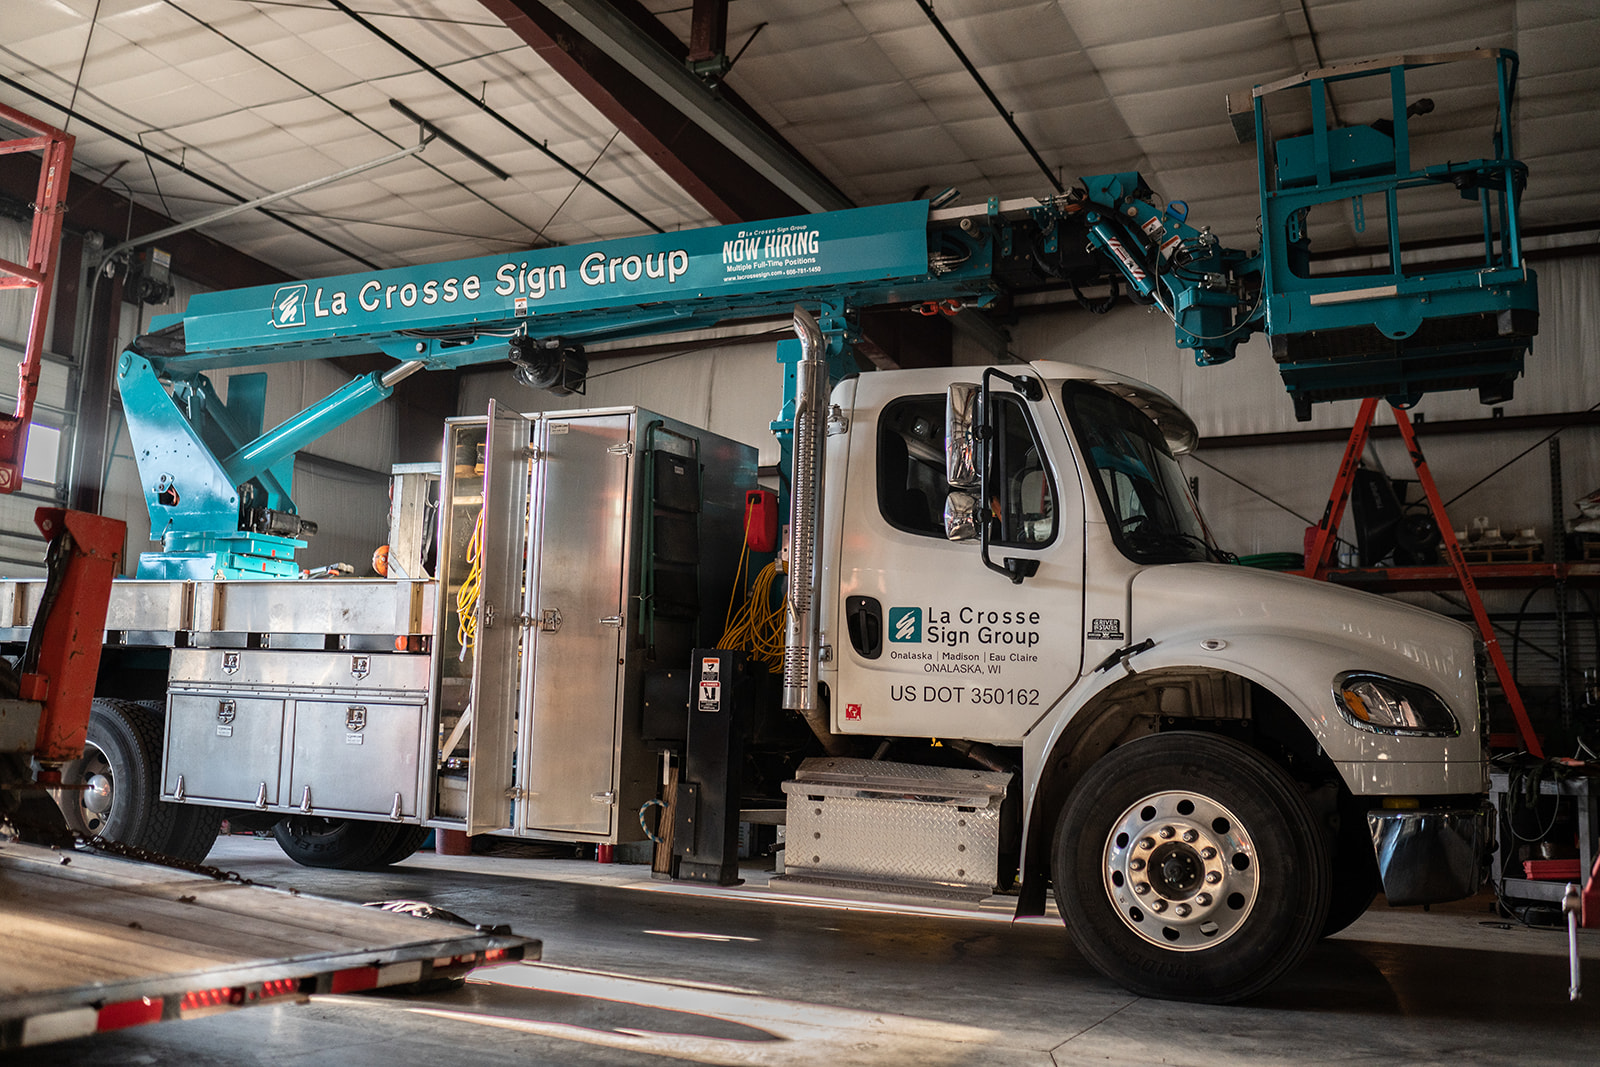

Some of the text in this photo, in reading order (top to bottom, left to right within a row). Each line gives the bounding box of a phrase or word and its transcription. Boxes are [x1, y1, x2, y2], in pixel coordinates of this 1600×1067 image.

[754, 228, 775, 236] Crosse
[722, 230, 819, 264] NOW HIRING
[726, 257, 816, 272] Multiple Full-Time Positions
[314, 249, 689, 317] La Crosse Sign Group
[928, 606, 1040, 624] La Crosse
[927, 626, 1040, 648] Sign Group
[890, 651, 1038, 662] Onalaska Madison Eau Claire
[923, 663, 1001, 675] ONALASKA, WI
[890, 685, 1040, 706] US DOT 350162
